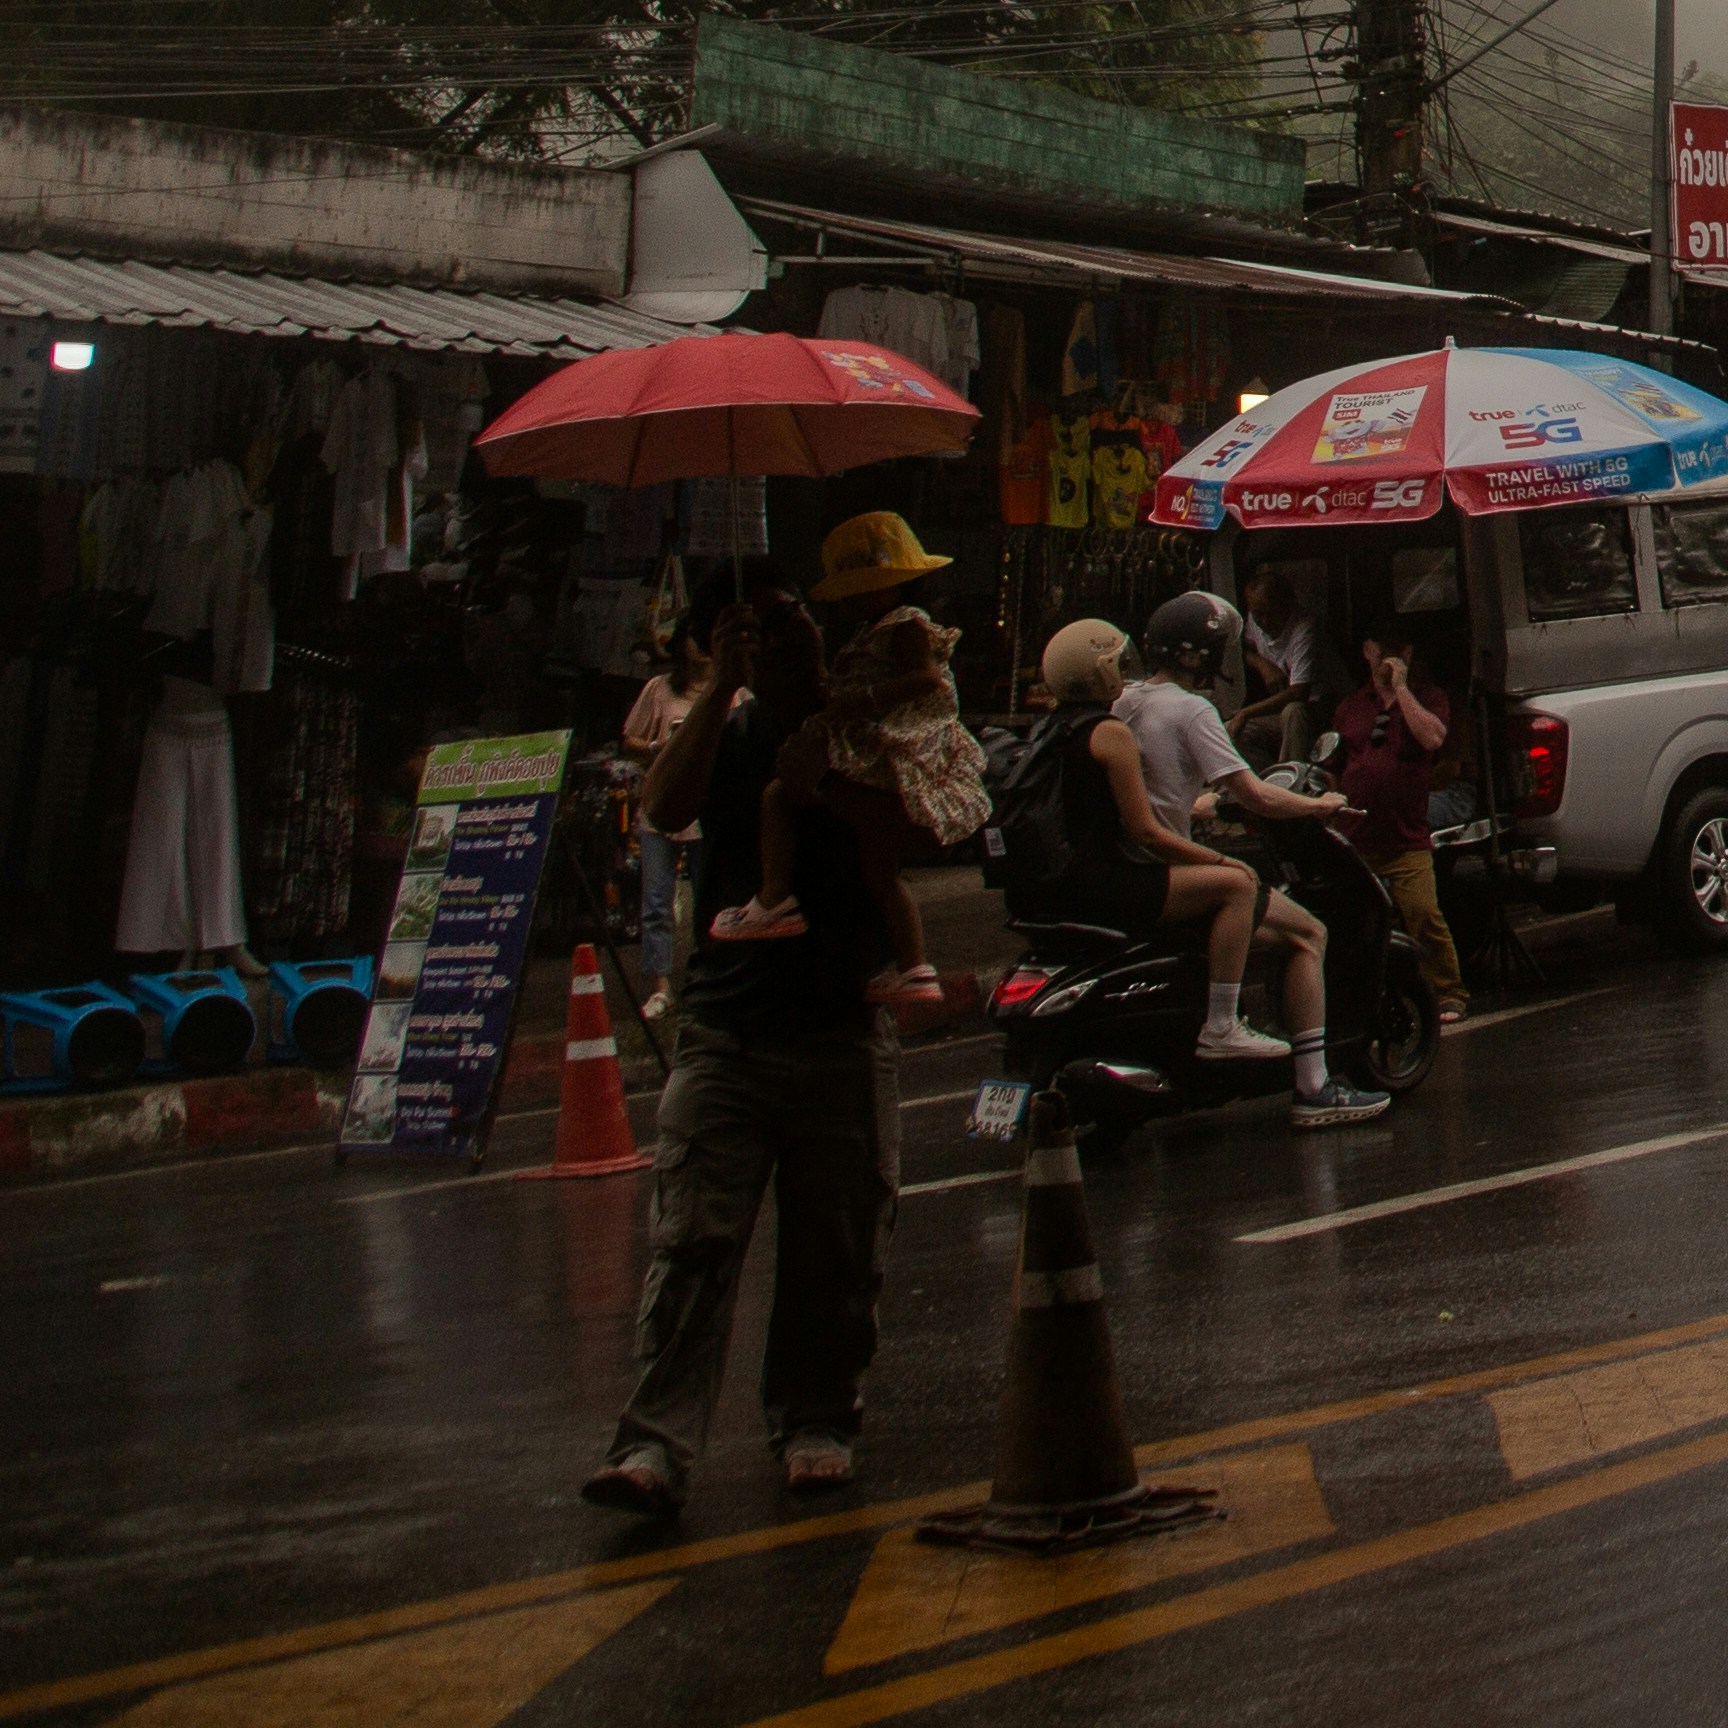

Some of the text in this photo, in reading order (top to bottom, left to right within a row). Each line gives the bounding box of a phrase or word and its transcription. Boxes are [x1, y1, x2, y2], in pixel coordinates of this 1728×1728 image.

[1334, 398, 1393, 409] TOURIST
[1363, 390, 1415, 401] THAILAND
[1336, 410, 1358, 419] SIM
[1468, 400, 1587, 421] true dtac
[1499, 417, 1584, 450] 5G
[1485, 456, 1628, 488] TRAVEL WITH 5G
[1242, 491, 1292, 511] true
[1332, 489, 1367, 507] dtac
[1370, 479, 1425, 510] 5G
[1488, 473, 1631, 504] ULTRA-FAST SPEED
